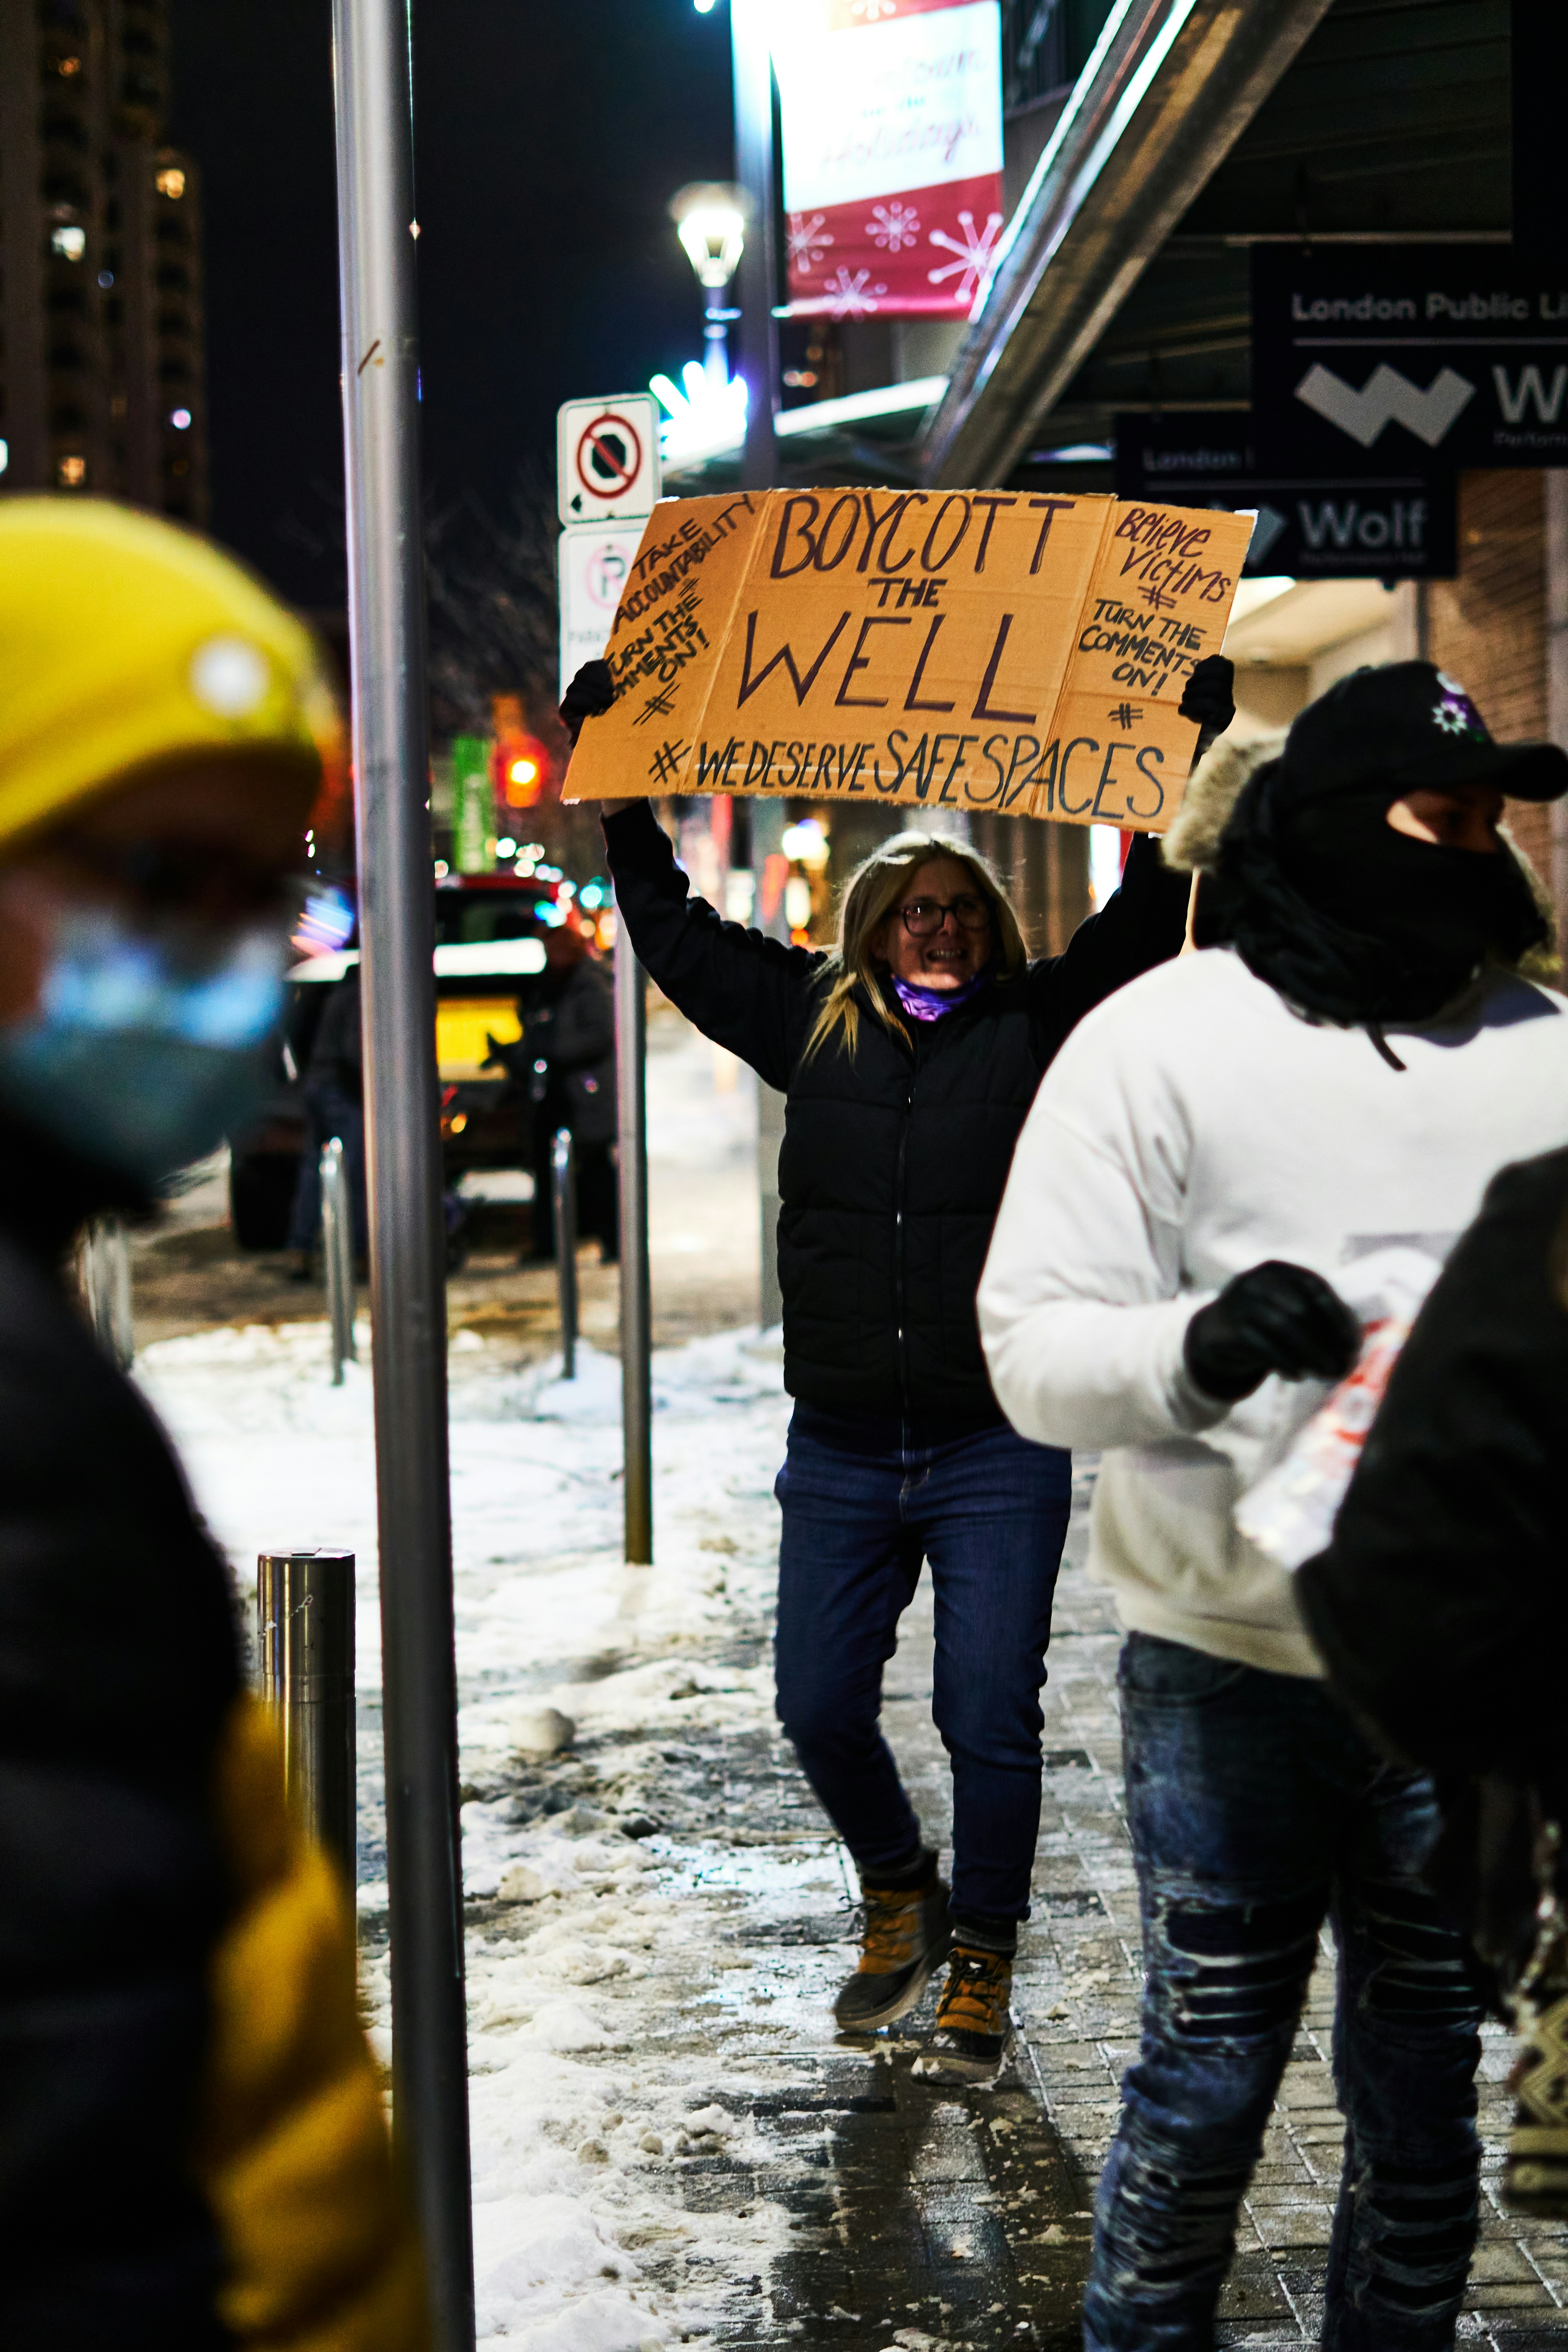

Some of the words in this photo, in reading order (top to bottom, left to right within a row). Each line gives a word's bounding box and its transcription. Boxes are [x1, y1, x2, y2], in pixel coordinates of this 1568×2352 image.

[1292, 293, 1415, 321] London
[1426, 293, 1528, 321] Public
[632, 518, 704, 580] TAKE
[769, 493, 1076, 579] BOYCOTT
[1298, 499, 1429, 548] Wolf
[613, 493, 755, 635] ACCOUNTABILITY
[652, 592, 704, 633] THE
[867, 578, 947, 608] THE
[1093, 598, 1155, 632] TURN
[1159, 617, 1207, 651] THE
[737, 610, 1036, 725] WELL
